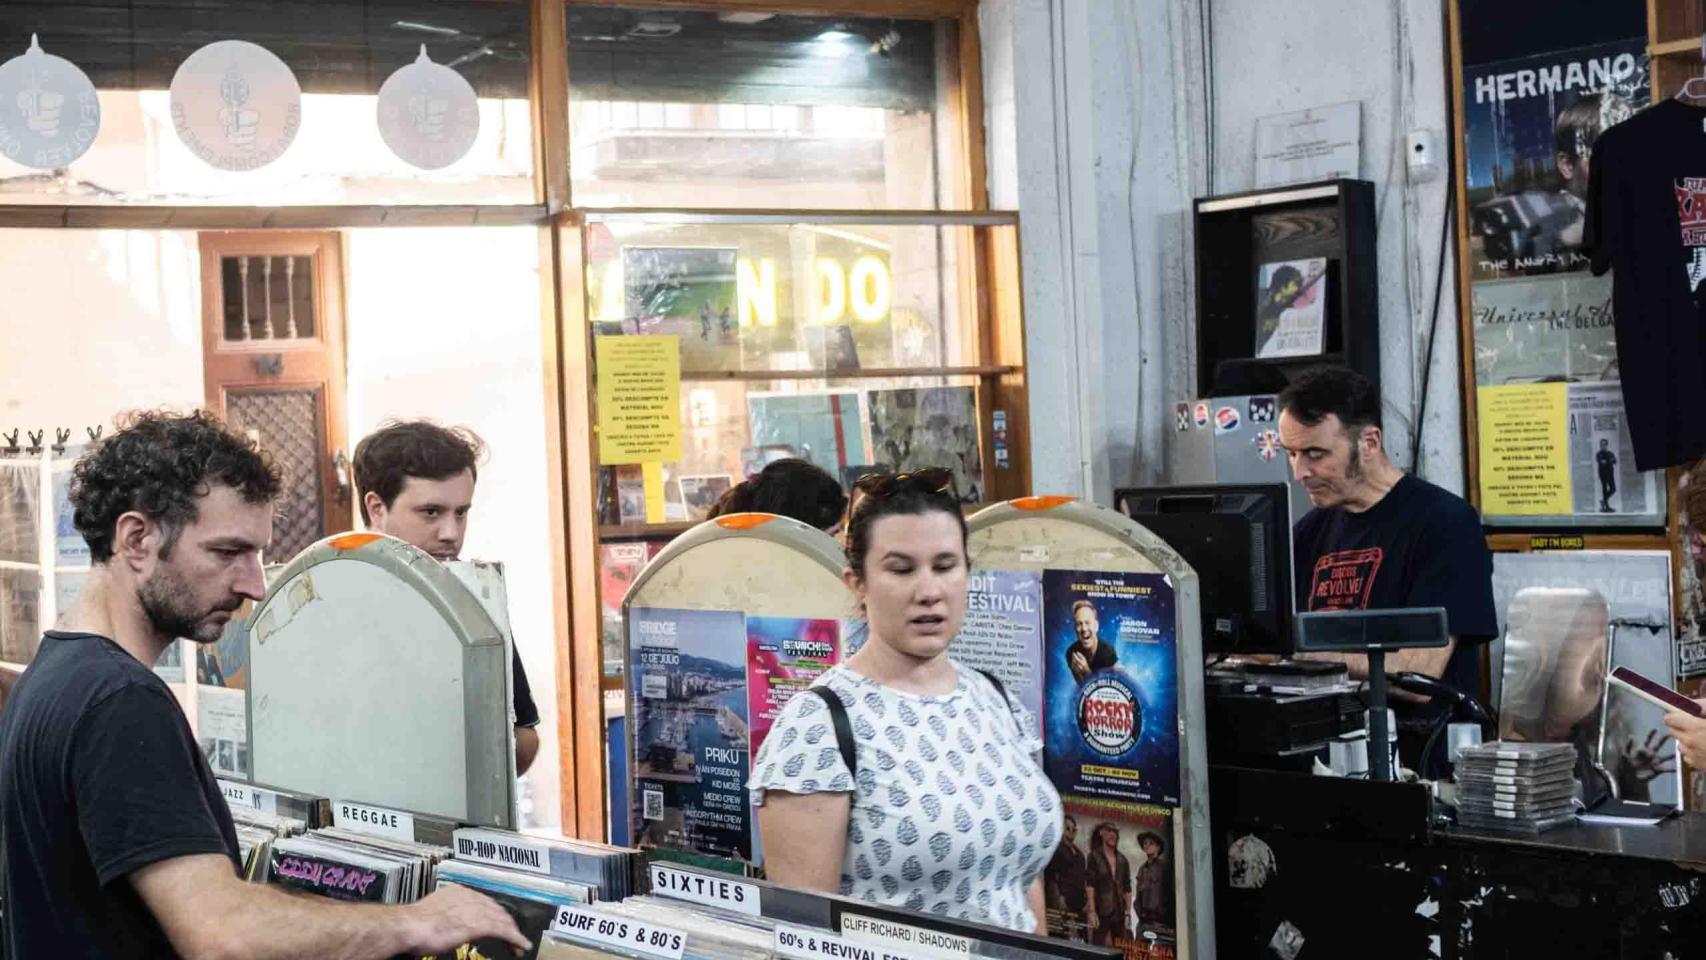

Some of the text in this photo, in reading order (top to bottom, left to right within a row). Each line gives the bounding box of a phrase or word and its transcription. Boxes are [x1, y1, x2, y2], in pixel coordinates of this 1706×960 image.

[1475, 53, 1635, 104] HERMANO
[1479, 260, 1509, 271] THE
[1476, 303, 1583, 325] Universal
[1575, 314, 1617, 330] DELGA
[968, 593, 1035, 613] ESTIVAL
[1084, 698, 1133, 719] ROCKY
[1086, 715, 1133, 733] HORROR
[704, 747, 739, 765] PRIKU
[223, 786, 244, 800] JAZZ
[342, 806, 399, 828] REGGAE
[458, 837, 541, 868] HIP-HOP NACIONAL
[657, 871, 745, 903] SIXTIES
[559, 911, 596, 932] SURF
[635, 928, 646, 943] &
[843, 917, 869, 933] CLIFF
[870, 921, 912, 943] RICHARD
[918, 931, 968, 953] SHADOWS
[808, 940, 818, 951] &
[821, 942, 875, 960] REVIVAL
